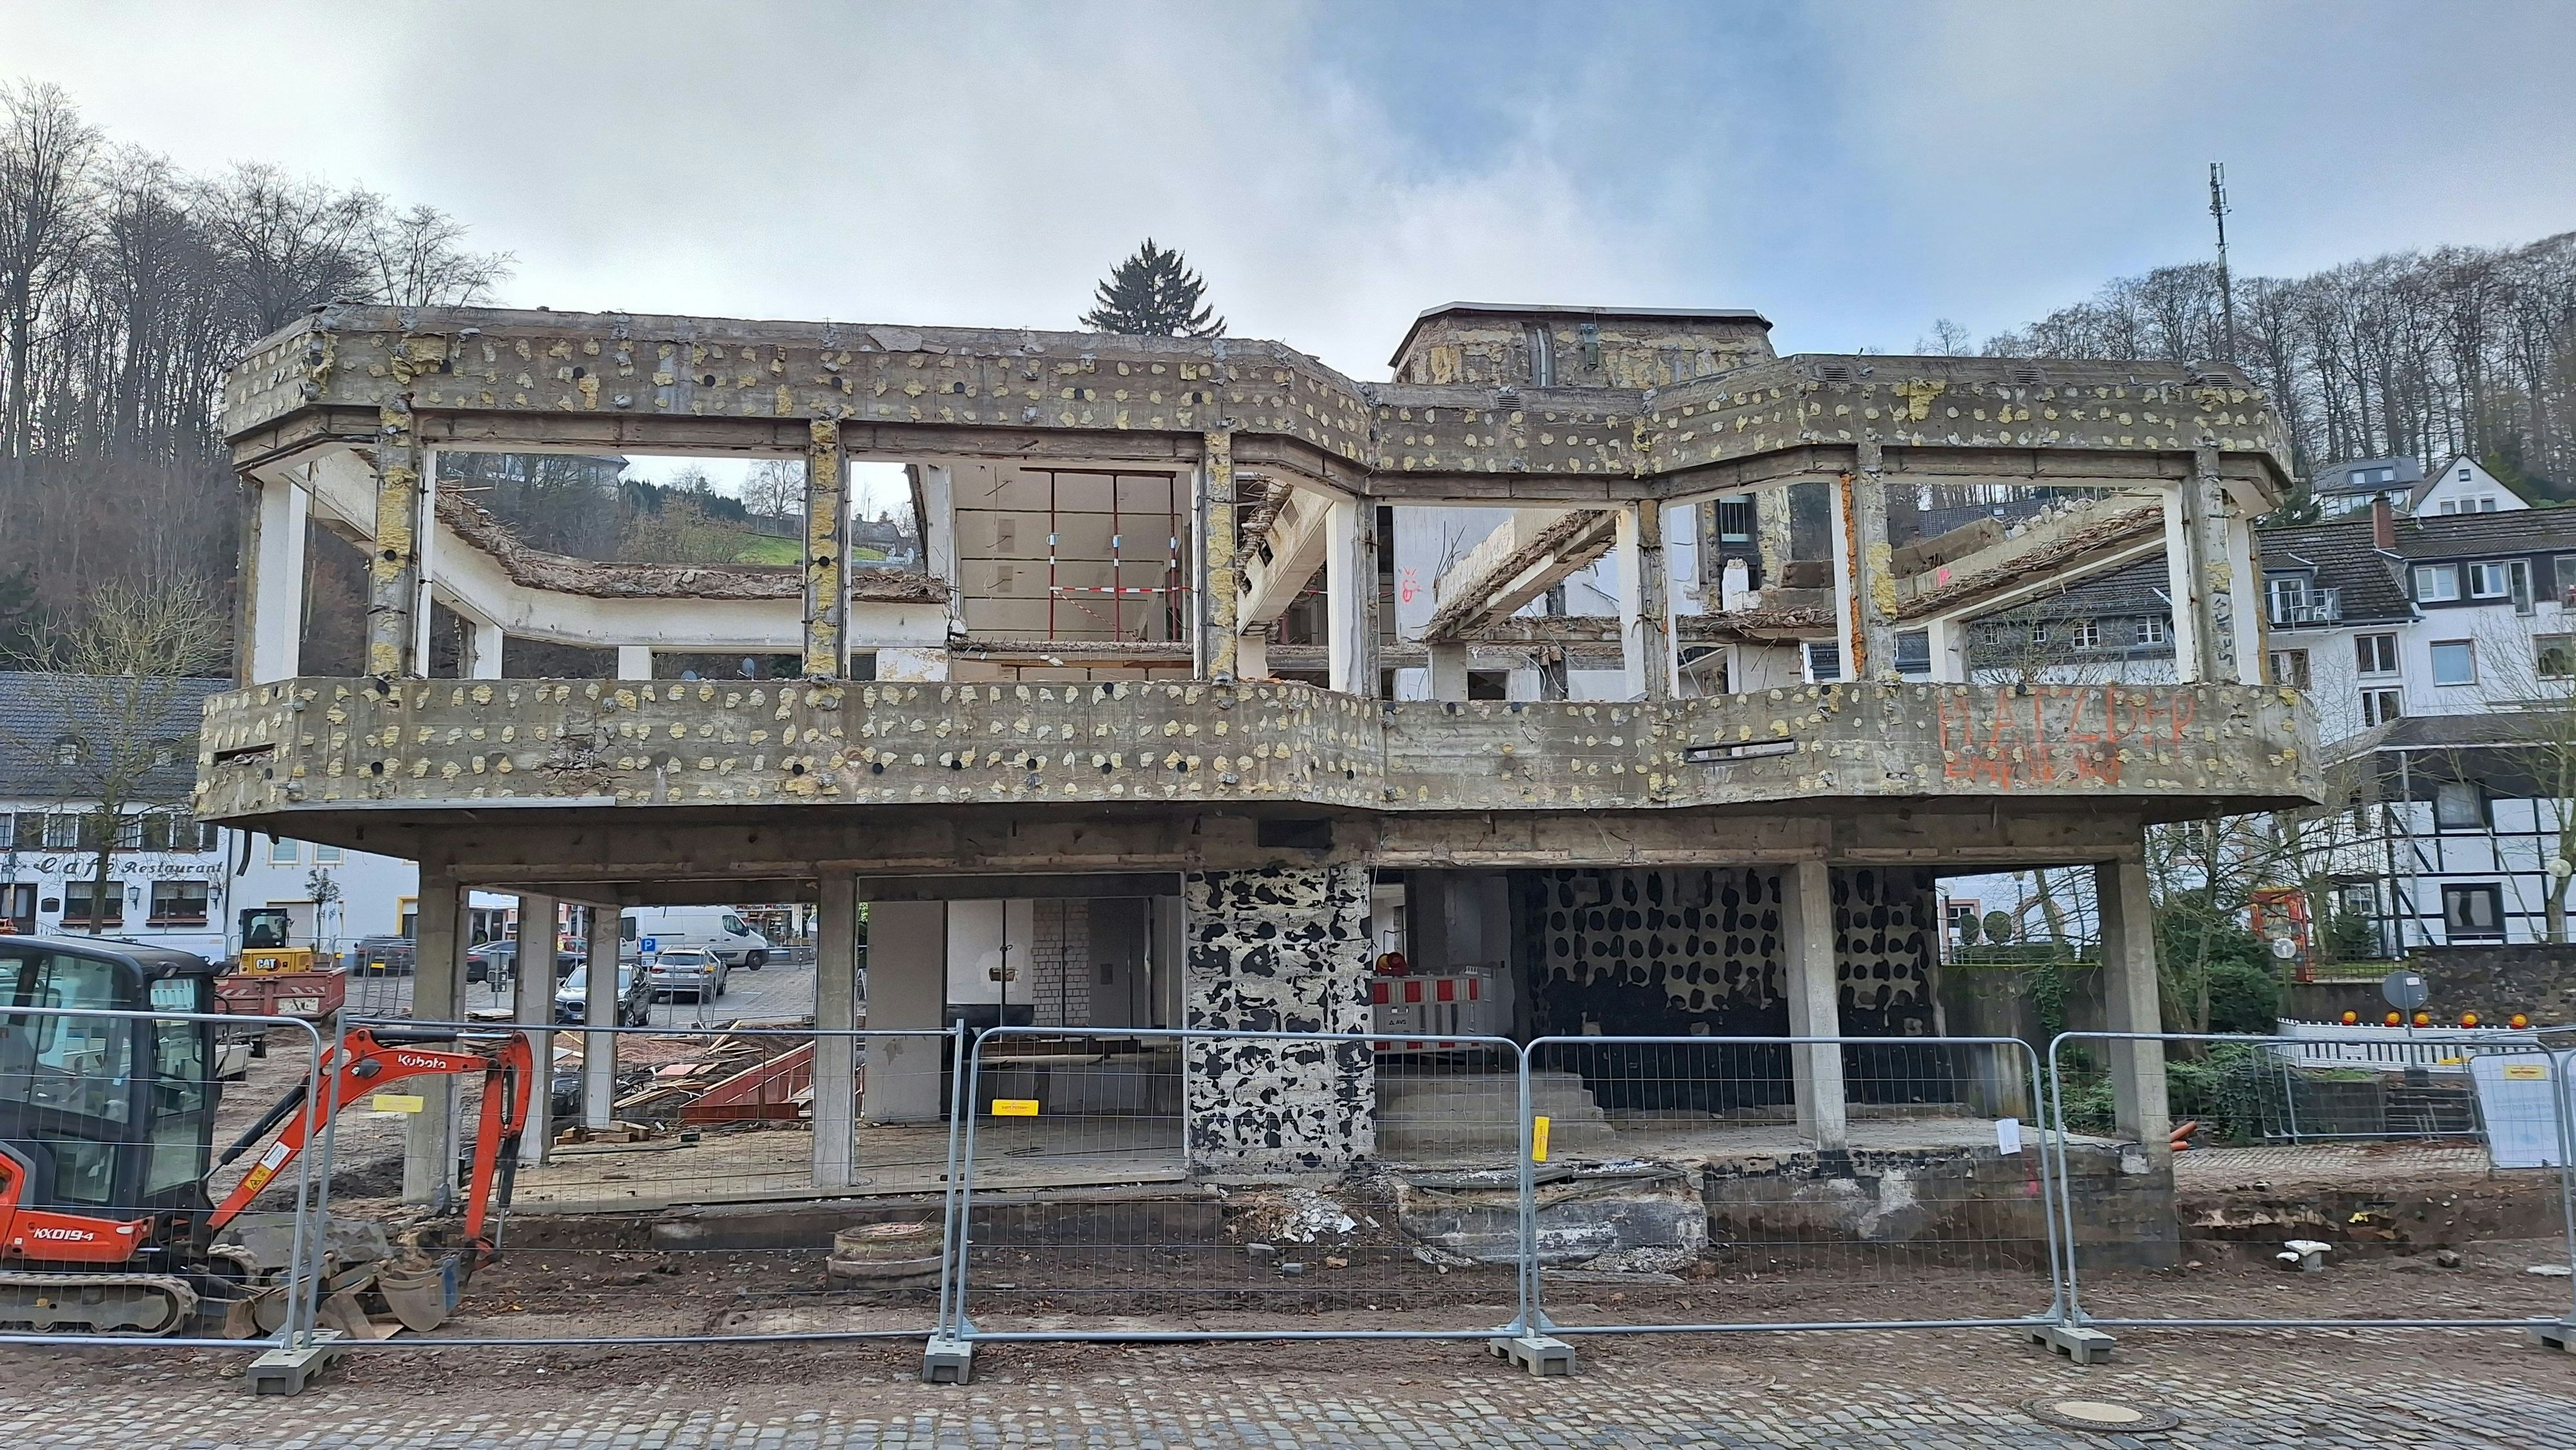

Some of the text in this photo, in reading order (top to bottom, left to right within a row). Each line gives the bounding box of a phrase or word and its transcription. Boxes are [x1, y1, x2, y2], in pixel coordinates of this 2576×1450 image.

[33, 857, 223, 877] Café Restaurant
[645, 940, 653, 951] P
[256, 958, 276, 969] CAT
[397, 1054, 446, 1069] Kubota
[33, 1228, 93, 1241] KX019-4
